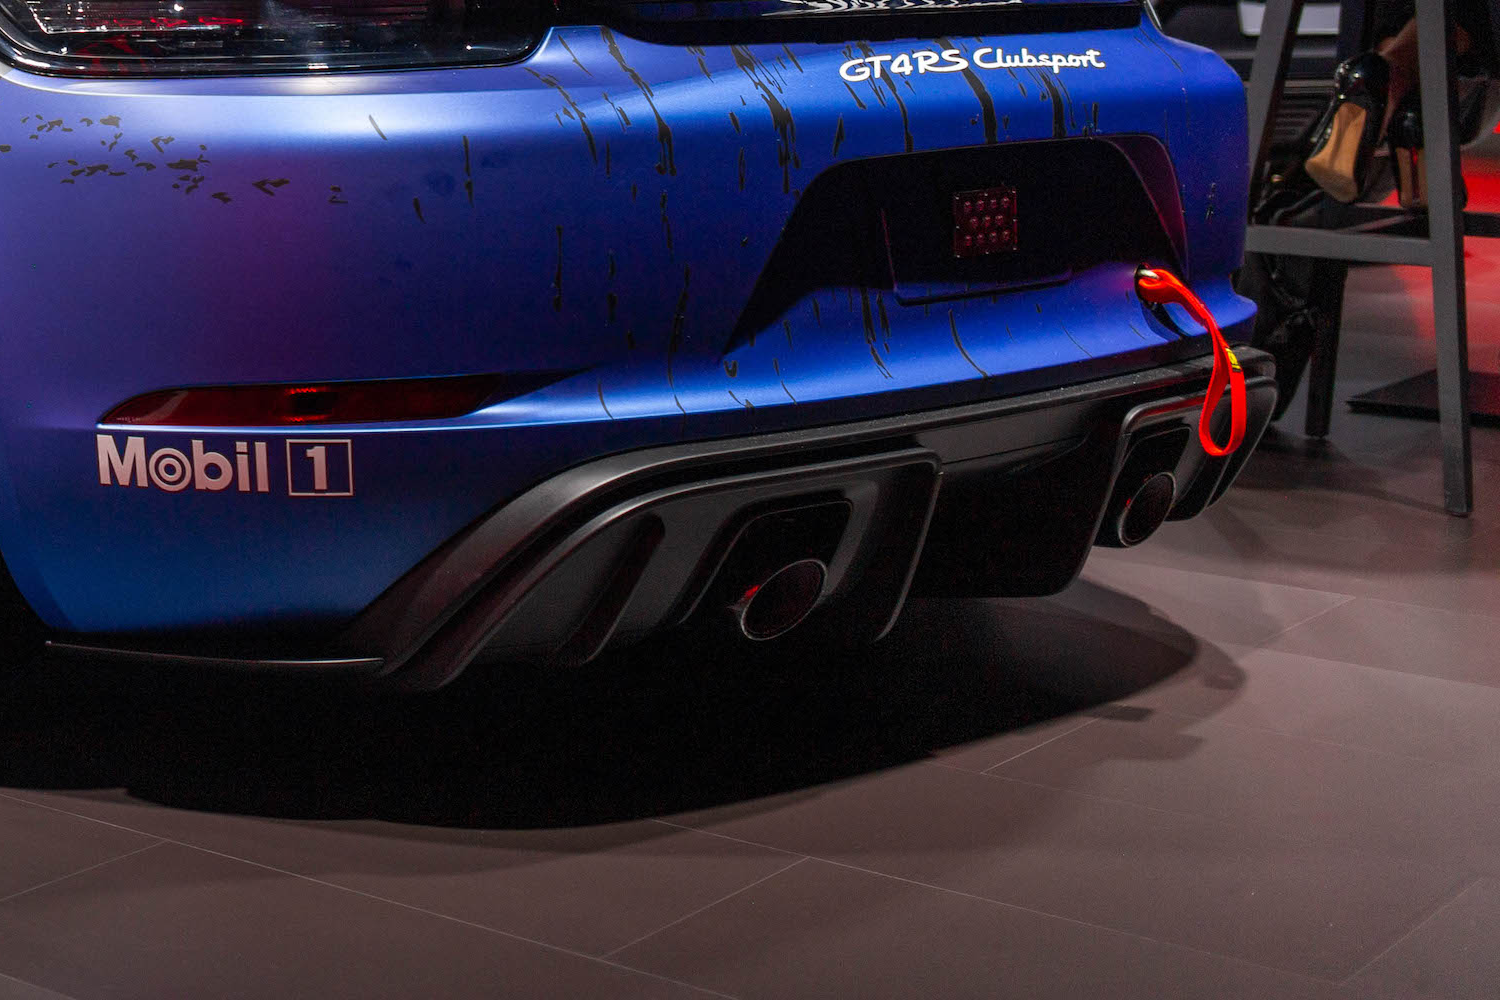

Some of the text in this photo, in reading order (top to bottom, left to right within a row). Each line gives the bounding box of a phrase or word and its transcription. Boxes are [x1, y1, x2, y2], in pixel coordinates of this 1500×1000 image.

[838, 47, 1105, 82] GT4RS Clubsport
[96, 433, 270, 493] Mobil
